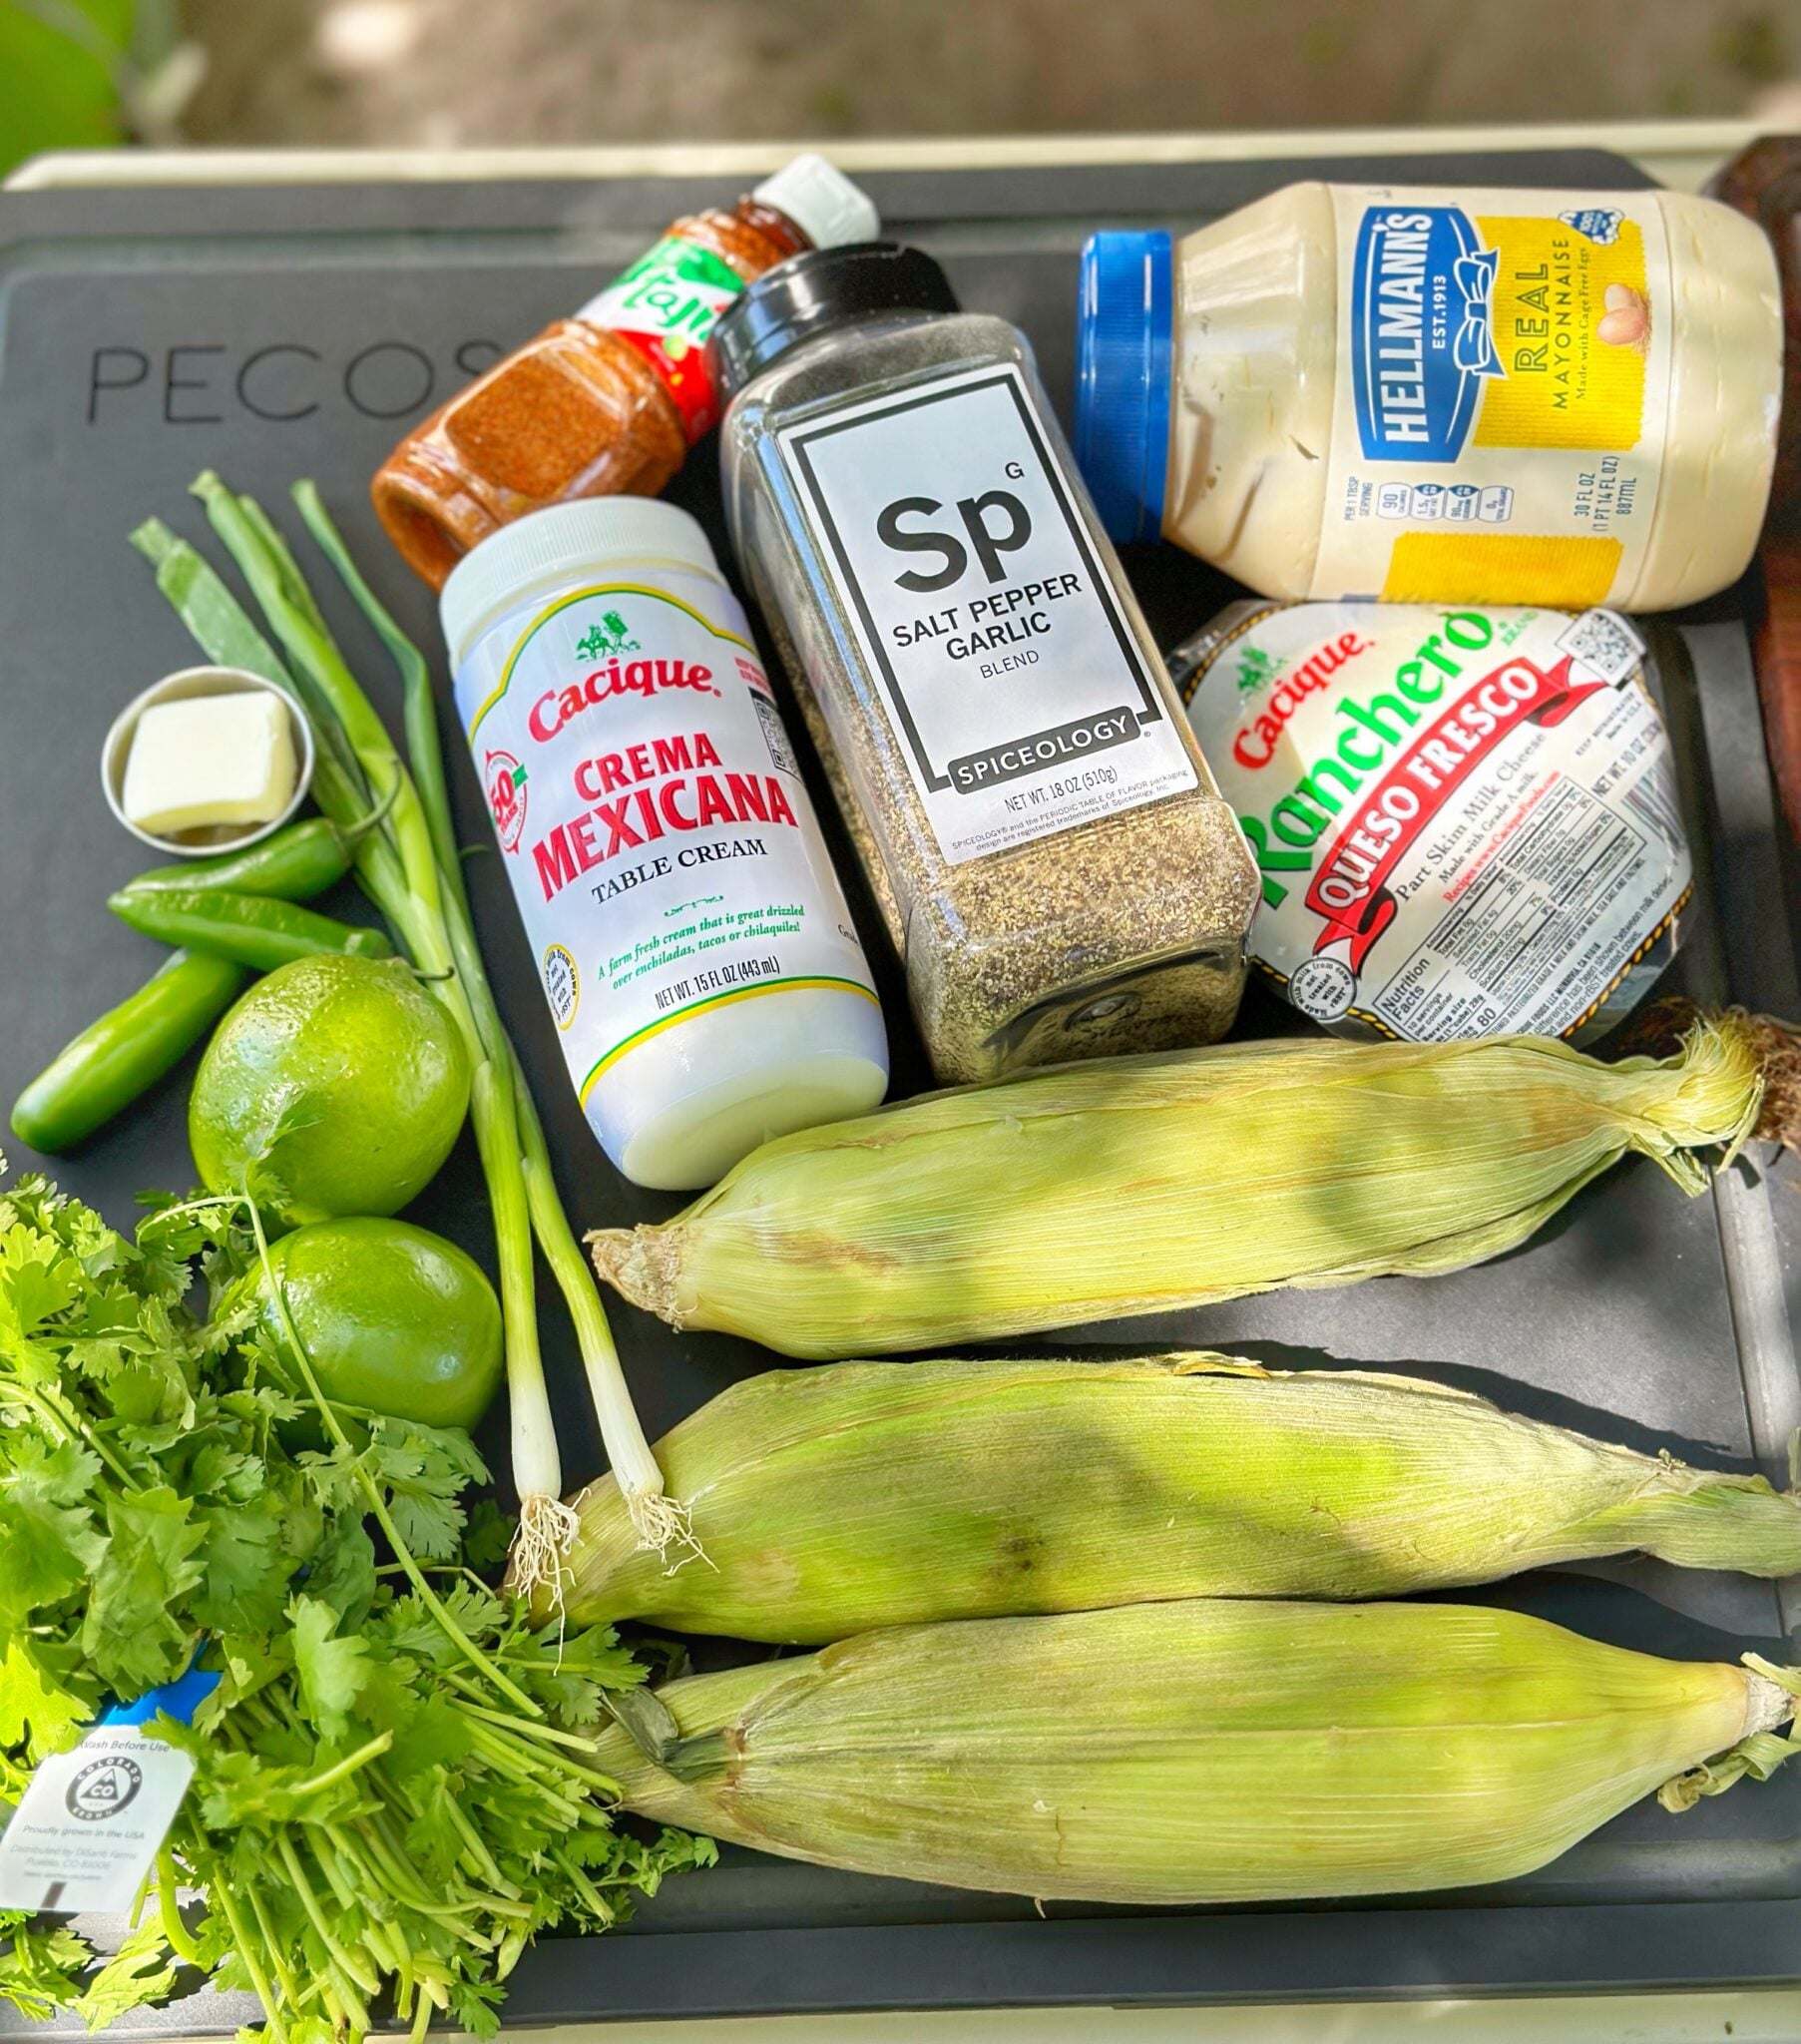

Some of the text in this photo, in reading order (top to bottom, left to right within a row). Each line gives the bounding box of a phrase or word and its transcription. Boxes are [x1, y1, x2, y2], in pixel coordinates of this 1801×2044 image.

[1372, 214, 1434, 442] HELLMANN'S
[1432, 274, 1447, 349] EST.1913
[1513, 262, 1550, 373] REAL
[1551, 239, 1570, 410] MAYONNAISE
[1575, 247, 1591, 399] Made with Cage Free Eggs
[87, 341, 502, 426] PECOS
[1005, 462, 1025, 479] G
[1347, 476, 1359, 497] TBSP
[1574, 472, 1594, 517] 30 FL OZ
[1590, 455, 1620, 532] (1 PT 14 FL OZ)
[1344, 505, 1356, 521] PER
[1359, 482, 1372, 516] SERVING
[1382, 492, 1398, 509] 90
[876, 490, 1032, 593] Sp
[893, 573, 1083, 648] SALT PEPPER
[946, 612, 1051, 660] GARLIC
[980, 650, 1040, 679] BLEND
[574, 733, 722, 800] CREMA
[957, 715, 1126, 785] SPICEOLOGY
[1237, 611, 1493, 909] Ranchero
[1590, 775, 1612, 797] NET
[1620, 751, 1636, 765] 10
[1630, 740, 1645, 754] OZ
[1005, 766, 1118, 813] NET WT. 18 OZ (510g)
[1025, 816, 1038, 825] the
[1040, 804, 1078, 820] PERIODIC
[1080, 794, 1104, 807] TABLE
[1119, 781, 1147, 794] FLAVOR
[1149, 769, 1186, 785] packaging
[1315, 663, 1540, 910] QUESO FRESCO
[532, 772, 799, 902] MEXICANA
[976, 838, 1002, 850] design
[1017, 820, 1055, 837] registered
[1057, 806, 1100, 823] trademarks
[1395, 729, 1547, 901] Part Skim Milk Cheese
[1438, 768, 1538, 883] Made with Grade A milk.
[1510, 853, 1526, 869] Total
[1524, 810, 1565, 854] Carbohydrate
[592, 839, 767, 904] TABLE CREAM
[1525, 838, 1556, 873] Dietary Fiber
[1535, 846, 1567, 880] Total Sugars
[1443, 866, 1481, 905] Recipes
[1551, 878, 1575, 902] Protein
[598, 905, 804, 980] A farm fresh cream that is great drizzled
[1439, 926, 1464, 955] Total Fat
[1453, 879, 1522, 957] Saturated Fat 20%
[1468, 894, 1542, 979] Cholesterol 20mg 7%
[612, 921, 800, 990] over enchiladas, tacos or chilaquiles!
[1462, 938, 1488, 966] Trans Fat
[1479, 960, 1505, 987] Sodium
[1503, 937, 1526, 961] 200mg
[1534, 997, 1570, 1035] difference
[1567, 983, 1582, 999] has
[1578, 965, 1597, 984] been
[1592, 940, 1617, 966] shown
[1613, 910, 1643, 942] between
[1638, 896, 1654, 912] milk
[655, 956, 780, 1010] NET WT. 15 FL OZ (443 mL)
[1308, 973, 1332, 999] treated
[1380, 957, 1431, 1011] Nutrition
[1391, 985, 1425, 1020] Facts
[1469, 994, 1483, 1008] 28g
[1556, 930, 1642, 1027] and non-rBST treated cows.
[1408, 1021, 1416, 1030] 10
[1415, 993, 1443, 1022] servings
[1414, 1024, 1426, 1036] per
[1424, 993, 1453, 1024] container
[1450, 998, 1466, 1014] size
[1477, 1007, 1497, 1027] 80
[78, 1758, 141, 1783] COLORADO
[111, 1741, 147, 1751] Before
[150, 1742, 170, 1753] Use
[90, 1785, 115, 1797] CO
[23, 1825, 59, 1836] Proudly
[62, 1828, 93, 1838] grown
[125, 1830, 145, 1839] USA
